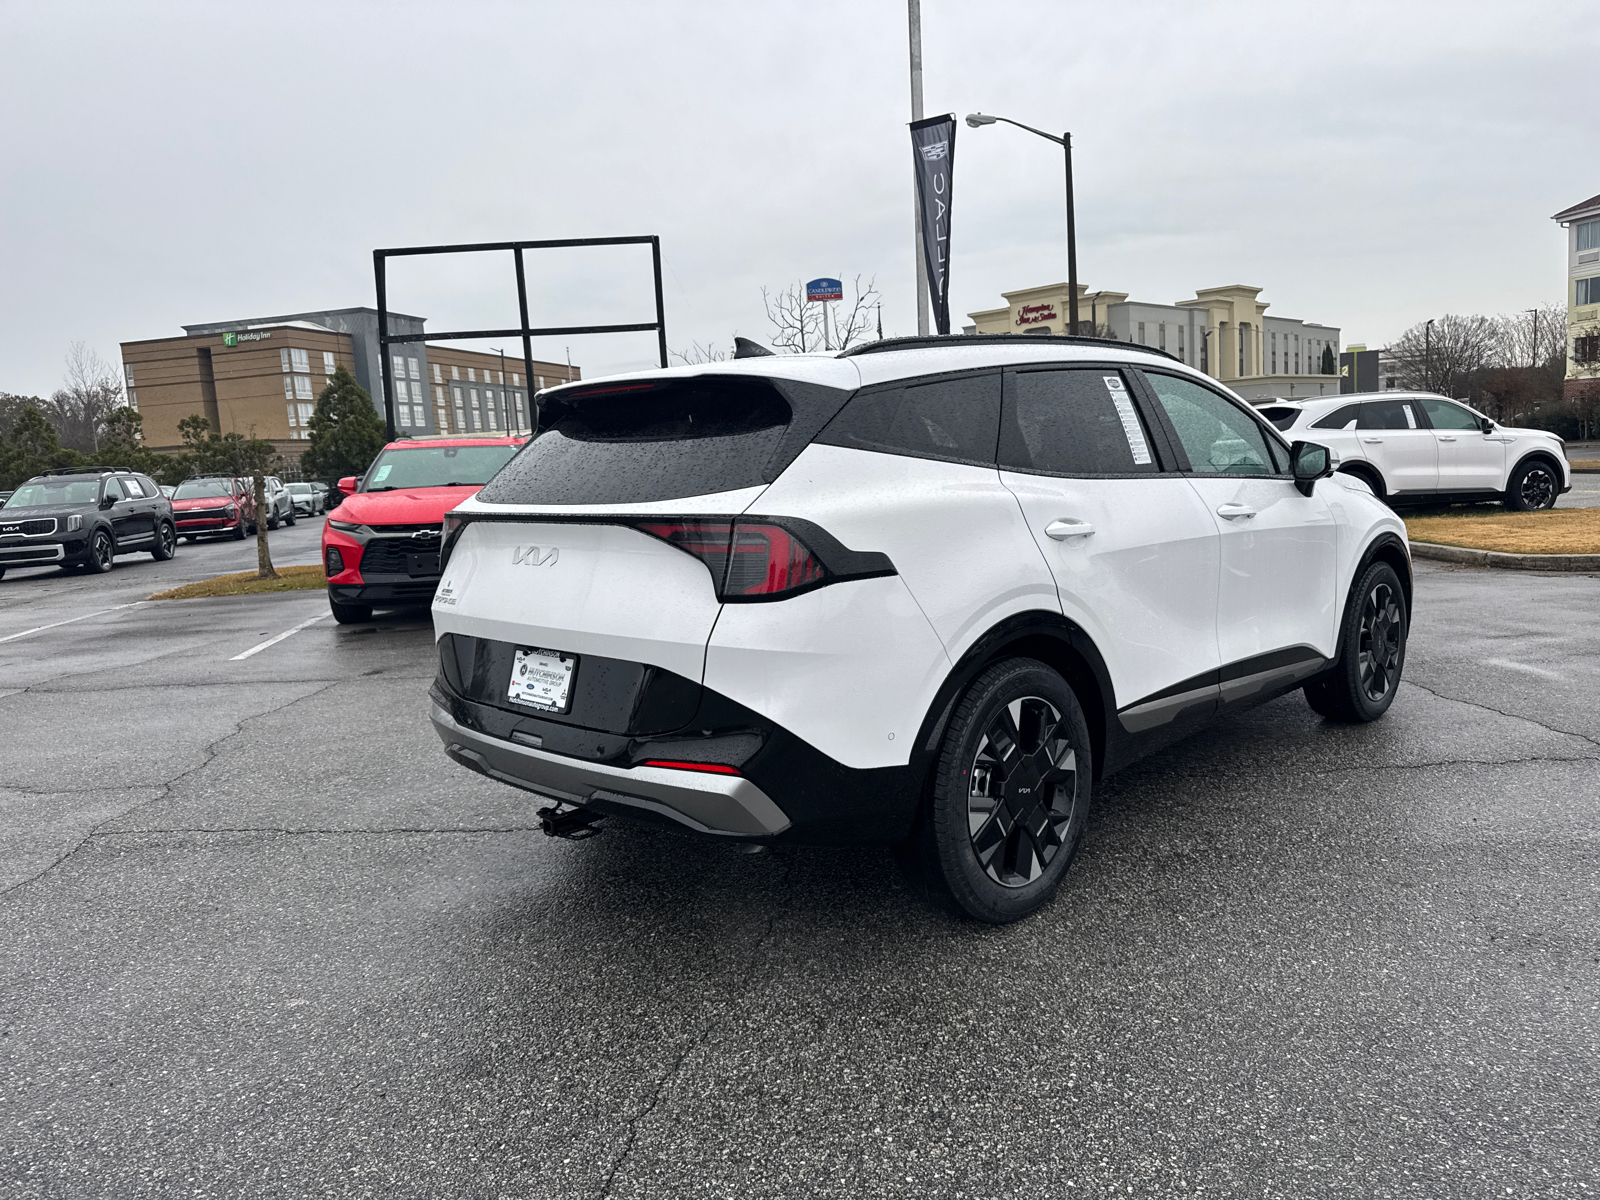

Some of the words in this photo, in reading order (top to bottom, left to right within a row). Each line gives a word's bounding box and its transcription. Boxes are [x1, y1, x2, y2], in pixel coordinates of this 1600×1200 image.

[1018, 304, 1054, 317] Hampton
[1015, 315, 1032, 326] Inn
[1038, 312, 1057, 321] Suites
[237, 333, 260, 341] Holiday
[260, 331, 271, 339] Inn
[512, 546, 559, 567] KIA
[527, 676, 549, 685] AUTOMOTIVE
[528, 667, 566, 682] HUTCHINSON
